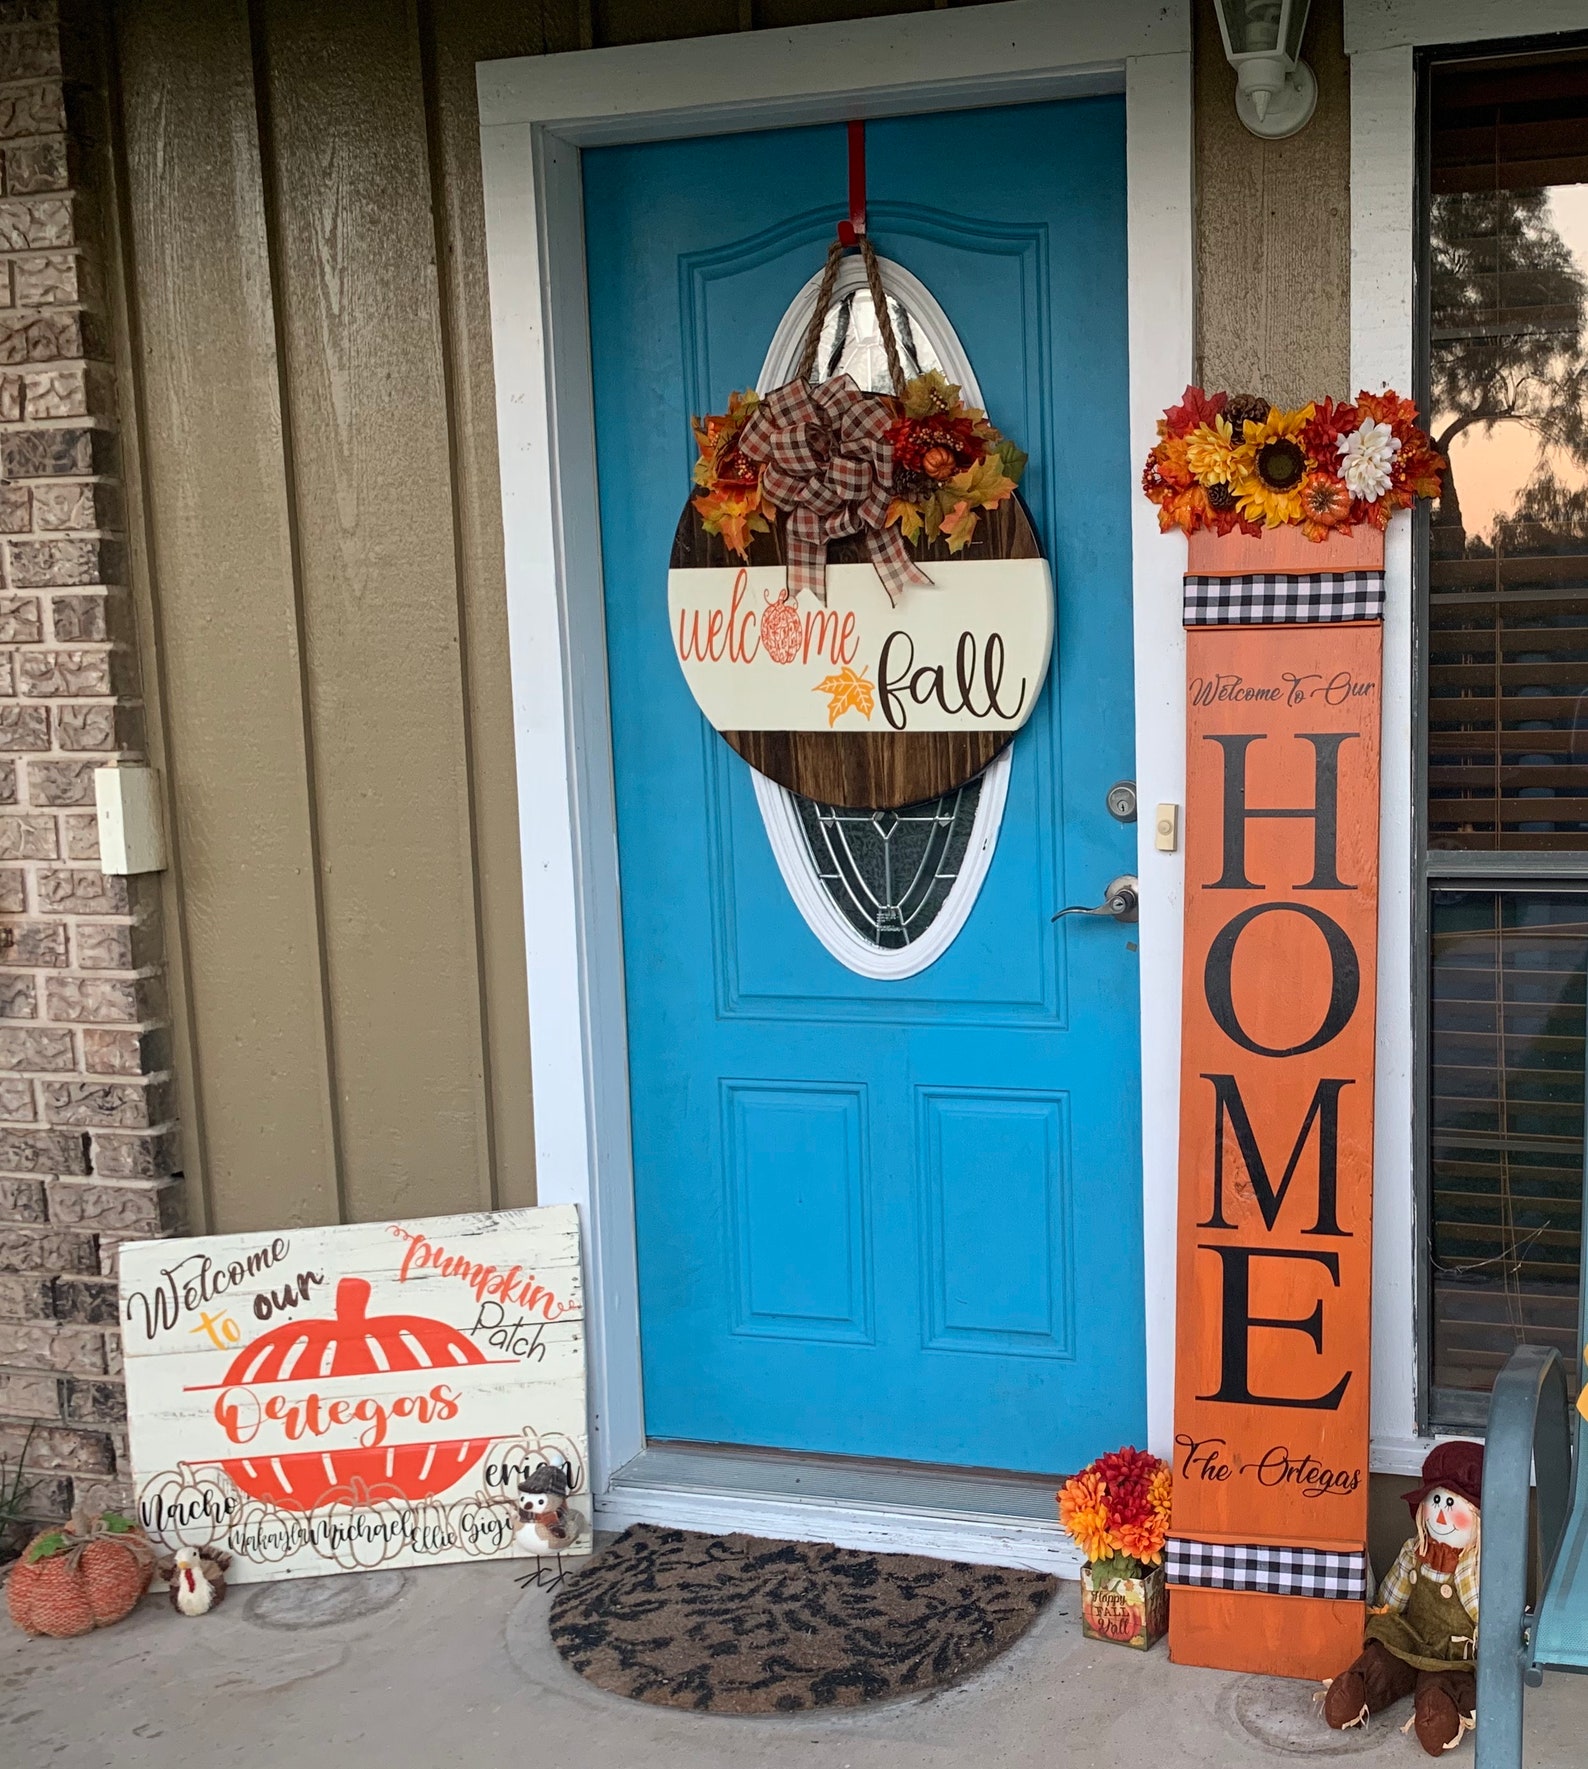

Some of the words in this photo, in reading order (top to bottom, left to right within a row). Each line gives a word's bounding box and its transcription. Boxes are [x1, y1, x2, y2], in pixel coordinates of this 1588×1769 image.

[878, 630, 1026, 730] fall
[1189, 673, 1284, 707] Welcome
[1281, 672, 1322, 707] To
[1310, 671, 1376, 706] Our
[1195, 732, 1361, 1411] HOME
[127, 1237, 290, 1340] Welcome
[385, 1225, 581, 1320] pumpkin
[189, 1308, 241, 1350] to
[253, 1267, 324, 1320] our
[471, 1301, 546, 1363] Patch
[214, 1384, 463, 1447] Ortegas
[1175, 1434, 1233, 1481] The
[1239, 1446, 1363, 1497] Ortegas
[142, 1489, 239, 1532] Nacho
[310, 1510, 413, 1550] Michael
[462, 1512, 514, 1546] Gigi
[1091, 1590, 1126, 1606] Happy
[1095, 1606, 1130, 1617] FALL
